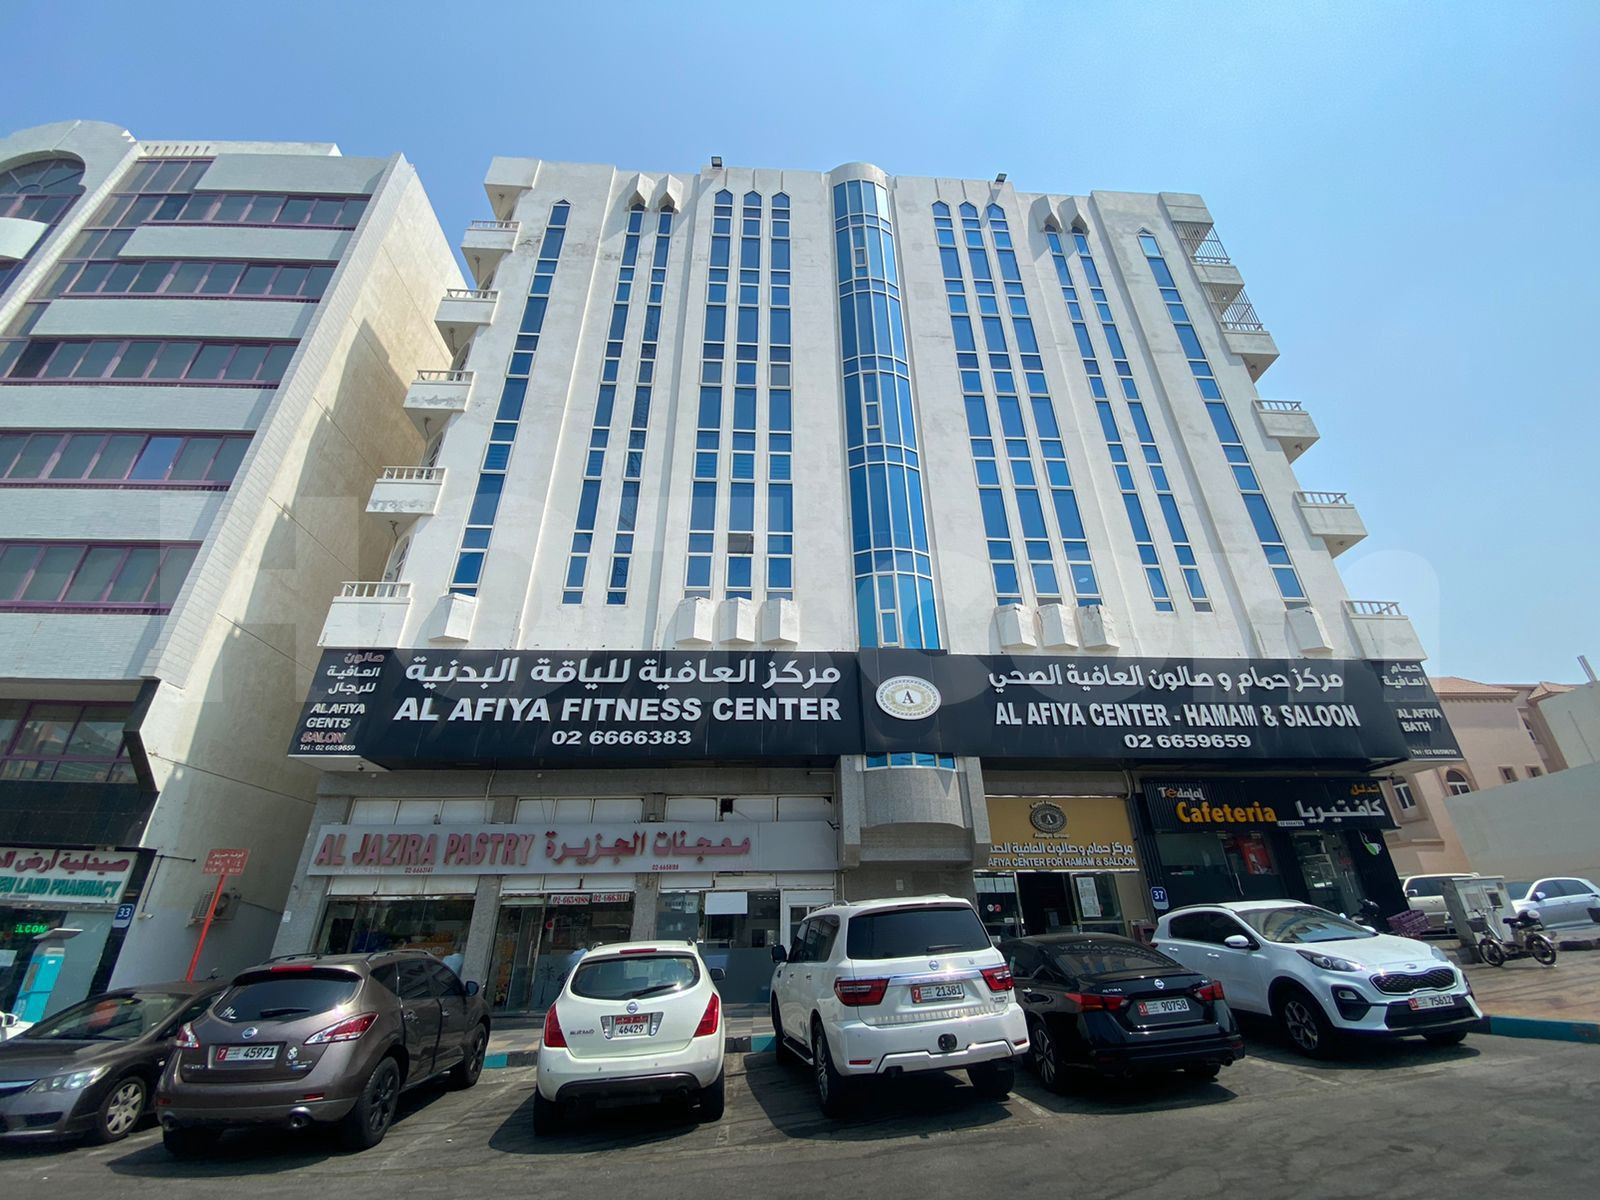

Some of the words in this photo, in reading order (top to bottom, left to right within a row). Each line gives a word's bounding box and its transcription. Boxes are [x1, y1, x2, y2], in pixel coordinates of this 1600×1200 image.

[344, 652, 384, 664] صالون
[327, 665, 381, 680] العافية
[405, 656, 520, 690] البدنية
[530, 657, 631, 690] للياقة
[638, 658, 755, 690] العافية
[762, 659, 841, 690] مركز
[1391, 663, 1421, 674] حمام
[989, 663, 1063, 693] الصحي
[1066, 663, 1144, 692] العافية
[1148, 664, 1214, 691] صالون
[1237, 667, 1290, 695] حمام
[1290, 667, 1344, 693] مركز
[1381, 675, 1428, 689] العافية
[328, 682, 377, 695] للرجال
[393, 697, 440, 721] AL
[448, 698, 551, 722] AFIYA
[560, 698, 702, 721] FITNESS
[712, 698, 842, 721] CENTER
[996, 702, 1022, 725] AL
[1027, 702, 1087, 726] AFIYA
[1089, 702, 1171, 727] CENTER
[1183, 703, 1259, 727] HAMAM
[1260, 704, 1279, 727] &
[1279, 704, 1361, 727] SALOON
[306, 717, 352, 729] GENTS
[1401, 721, 1432, 733] BATH
[301, 731, 346, 743] SALON
[551, 730, 582, 745] 02
[589, 730, 692, 745] 6666383
[1124, 734, 1154, 748] 02
[1157, 734, 1252, 749] 6659659
[1175, 801, 1278, 823] Cafeteria
[1295, 799, 1385, 823] كافتيريا
[315, 834, 347, 865] AL
[352, 833, 437, 865] JAZIRA
[443, 833, 535, 865] PASTRY
[545, 831, 646, 865] الجزيرة
[652, 831, 752, 863] معجنات
[1012, 842, 1046, 857] العافية
[1086, 842, 1110, 856] حمام
[1111, 842, 1133, 856] مركز
[1012, 858, 1045, 867] CENTER
[1046, 858, 1063, 867] FOR
[1064, 858, 1094, 867] HAMAM
[1103, 858, 1136, 867] SALOON
[1153, 890, 1164, 900] 37
[118, 908, 131, 917] 33
[936, 984, 962, 997] 21381
[1160, 1000, 1187, 1011] 90758
[618, 1024, 644, 1034] 46429
[243, 1047, 276, 1058] 45971
